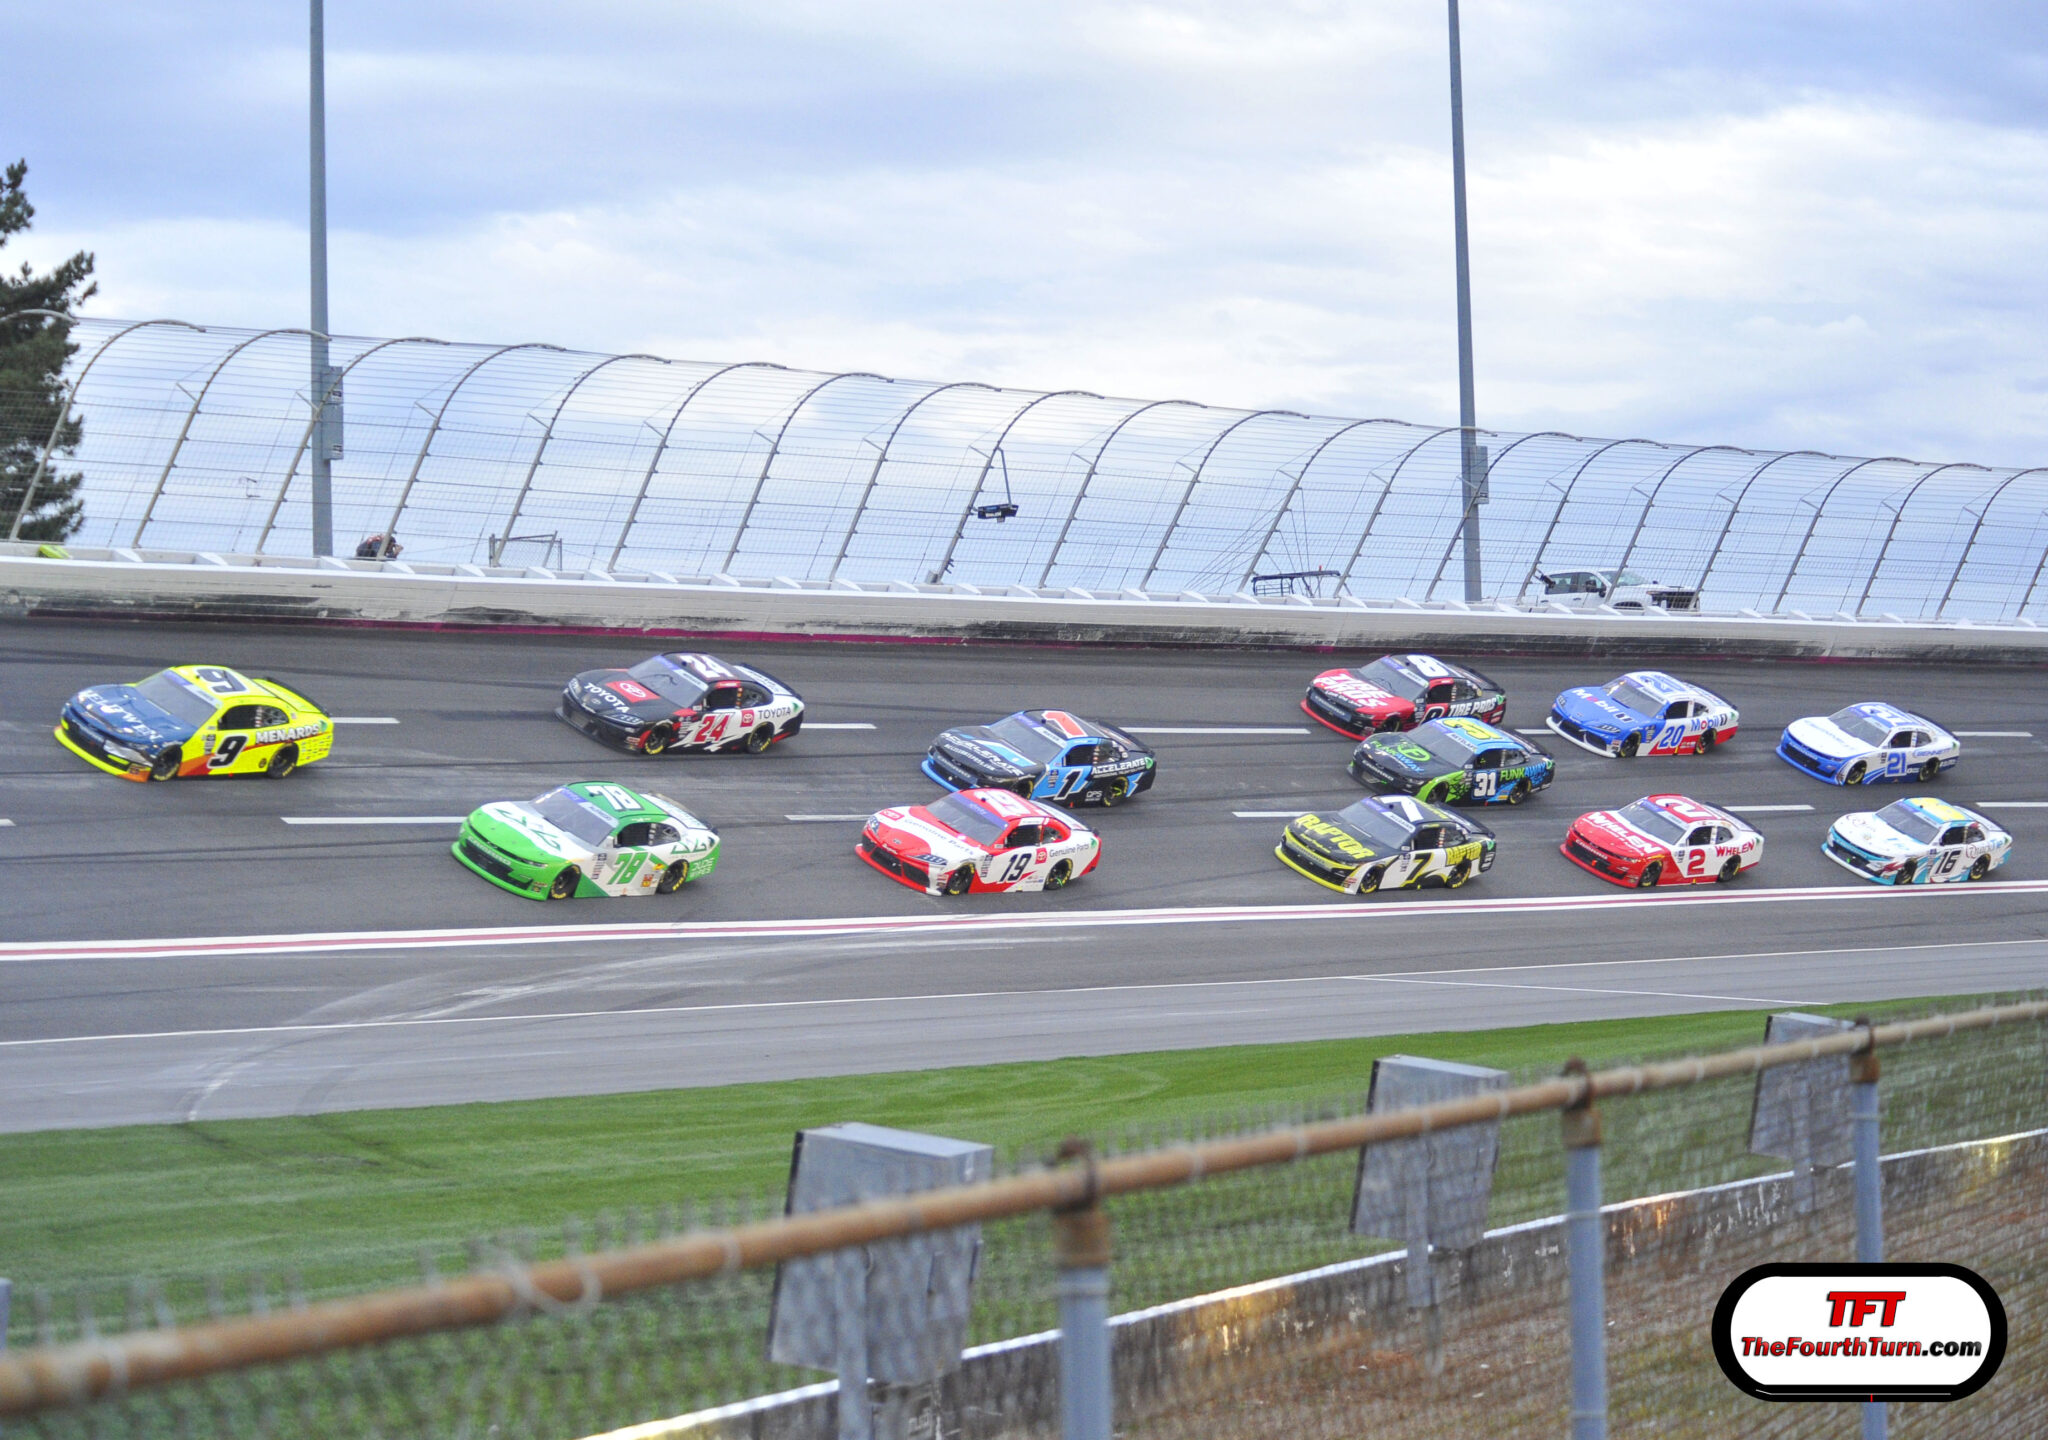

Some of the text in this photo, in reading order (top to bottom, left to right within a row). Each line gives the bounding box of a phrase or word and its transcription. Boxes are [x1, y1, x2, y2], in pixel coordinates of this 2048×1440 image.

[195, 666, 249, 695] 9
[584, 682, 630, 713] TOYOTA
[1448, 702, 1473, 718] TIRE
[1571, 689, 1620, 713] Mobil
[757, 706, 792, 720] TOYOTA
[1691, 714, 1720, 732] Mobil
[255, 724, 320, 745] MENARDS
[692, 713, 732, 743] 24
[1658, 724, 1686, 749] 20
[206, 733, 249, 769] 9
[1887, 751, 1907, 775] 21
[1091, 757, 1146, 775] ACCELERATE
[1053, 768, 1084, 801] 1
[1473, 771, 1497, 798] 31
[1294, 812, 1376, 860] RAPTOR
[1587, 811, 1663, 855] WHELEN
[1049, 845, 1076, 858] Genuine
[1686, 848, 1706, 876] 2
[1714, 839, 1756, 858] WHELEN
[1934, 849, 1962, 875] 16
[606, 850, 650, 886] 78
[998, 852, 1033, 883] 19
[1406, 852, 1433, 884] 7
